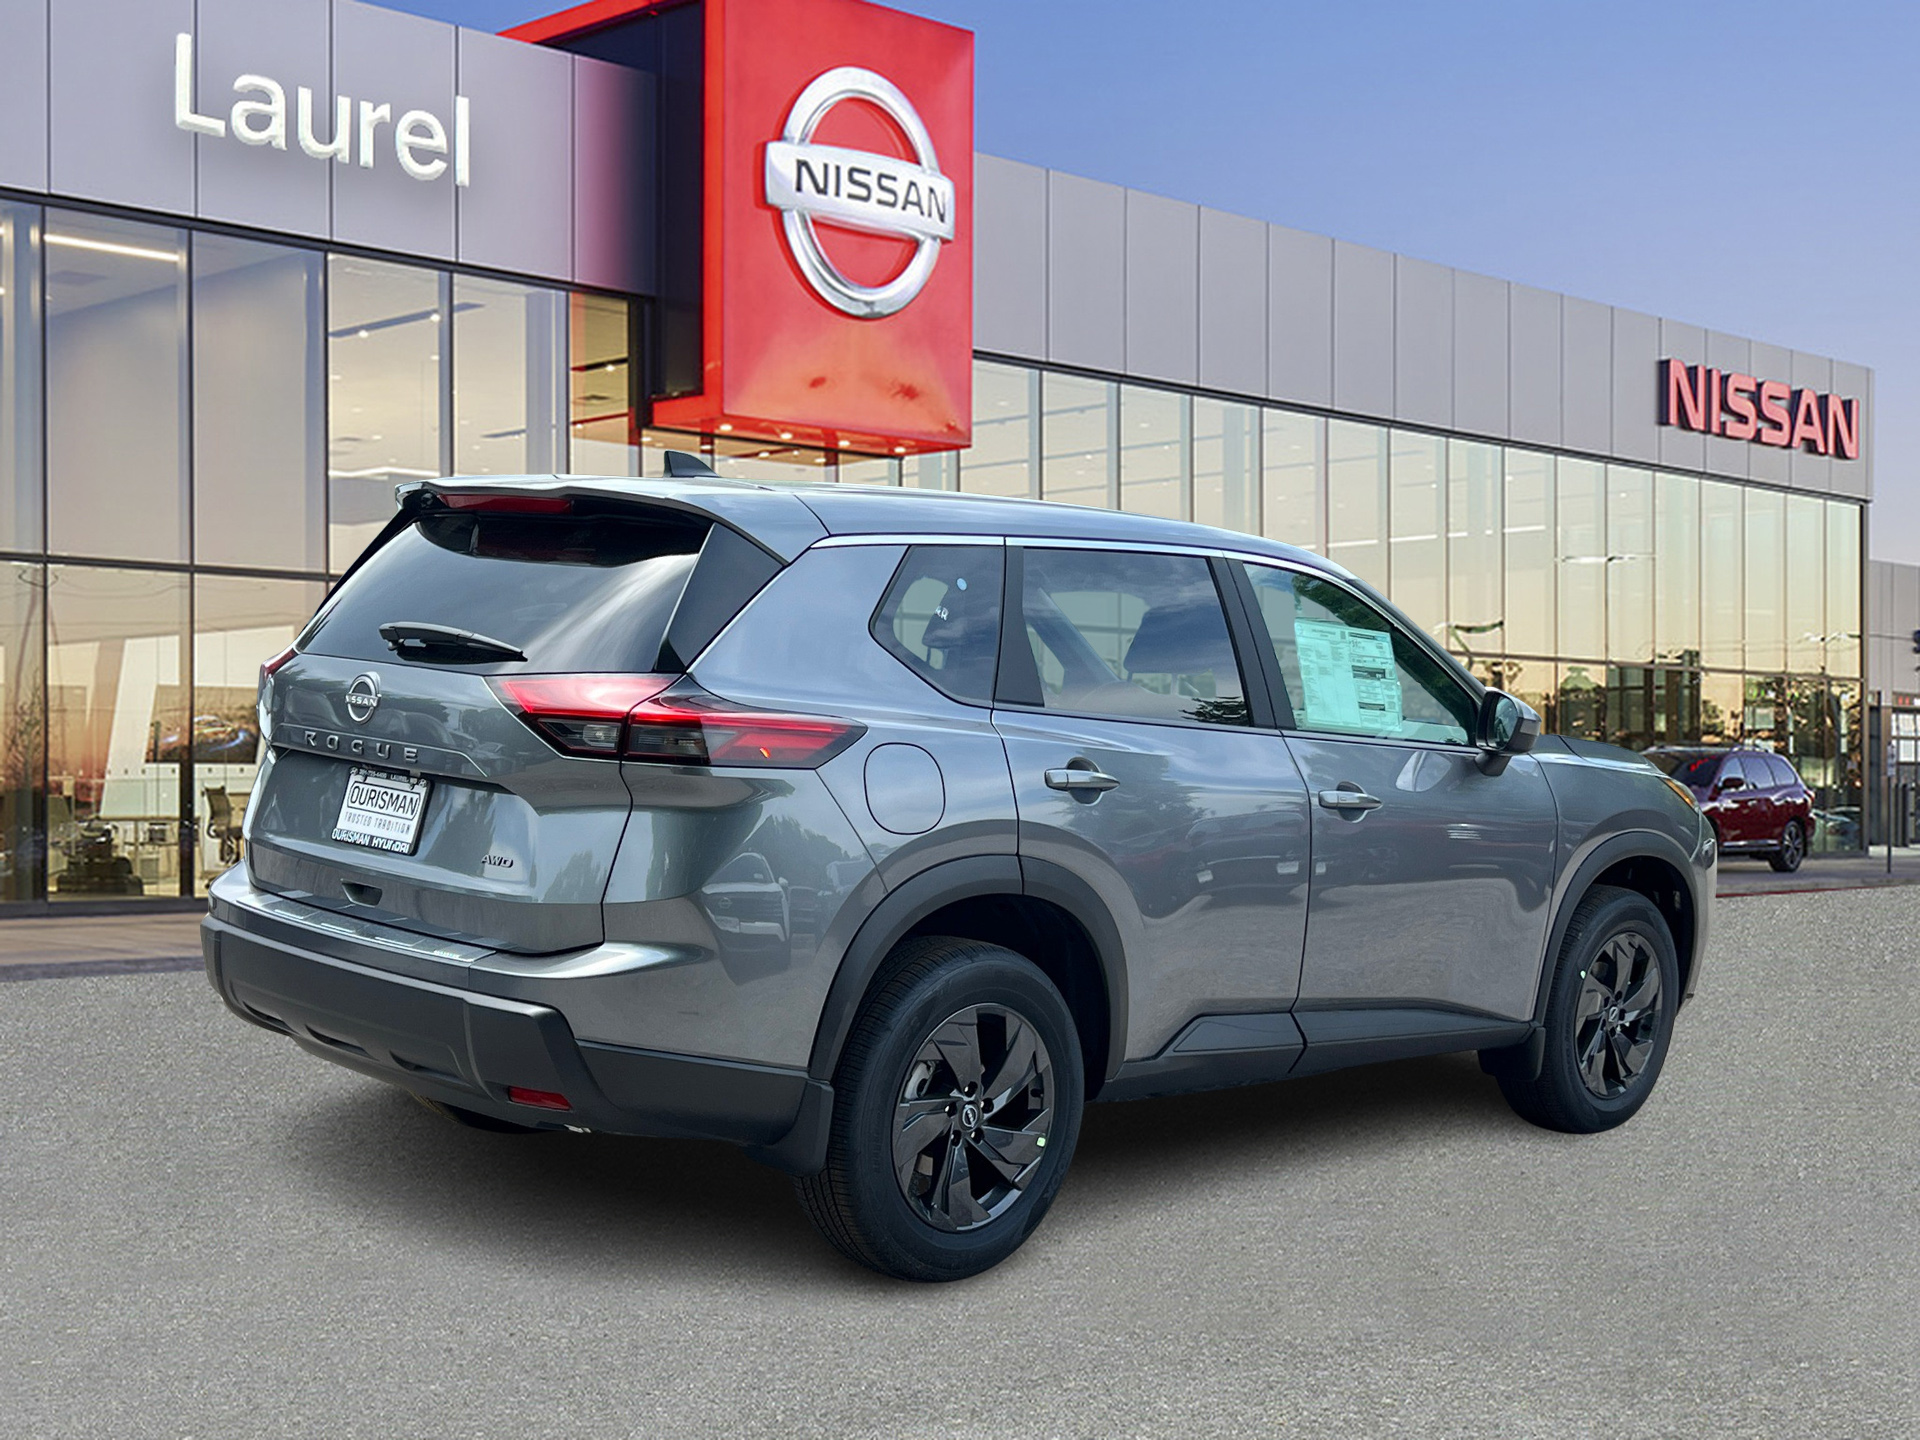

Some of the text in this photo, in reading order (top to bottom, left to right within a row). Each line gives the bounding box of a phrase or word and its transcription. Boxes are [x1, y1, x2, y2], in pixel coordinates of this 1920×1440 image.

[175, 33, 469, 187] Laurel
[795, 158, 946, 224] NISSAN
[1665, 358, 1859, 460] NISSAN
[304, 730, 418, 763] ROGUE
[350, 786, 419, 816] OURISMAN
[331, 828, 371, 847] OURISMAN
[344, 811, 411, 835] TRUSTED TRADITION
[480, 854, 514, 869] AWD
